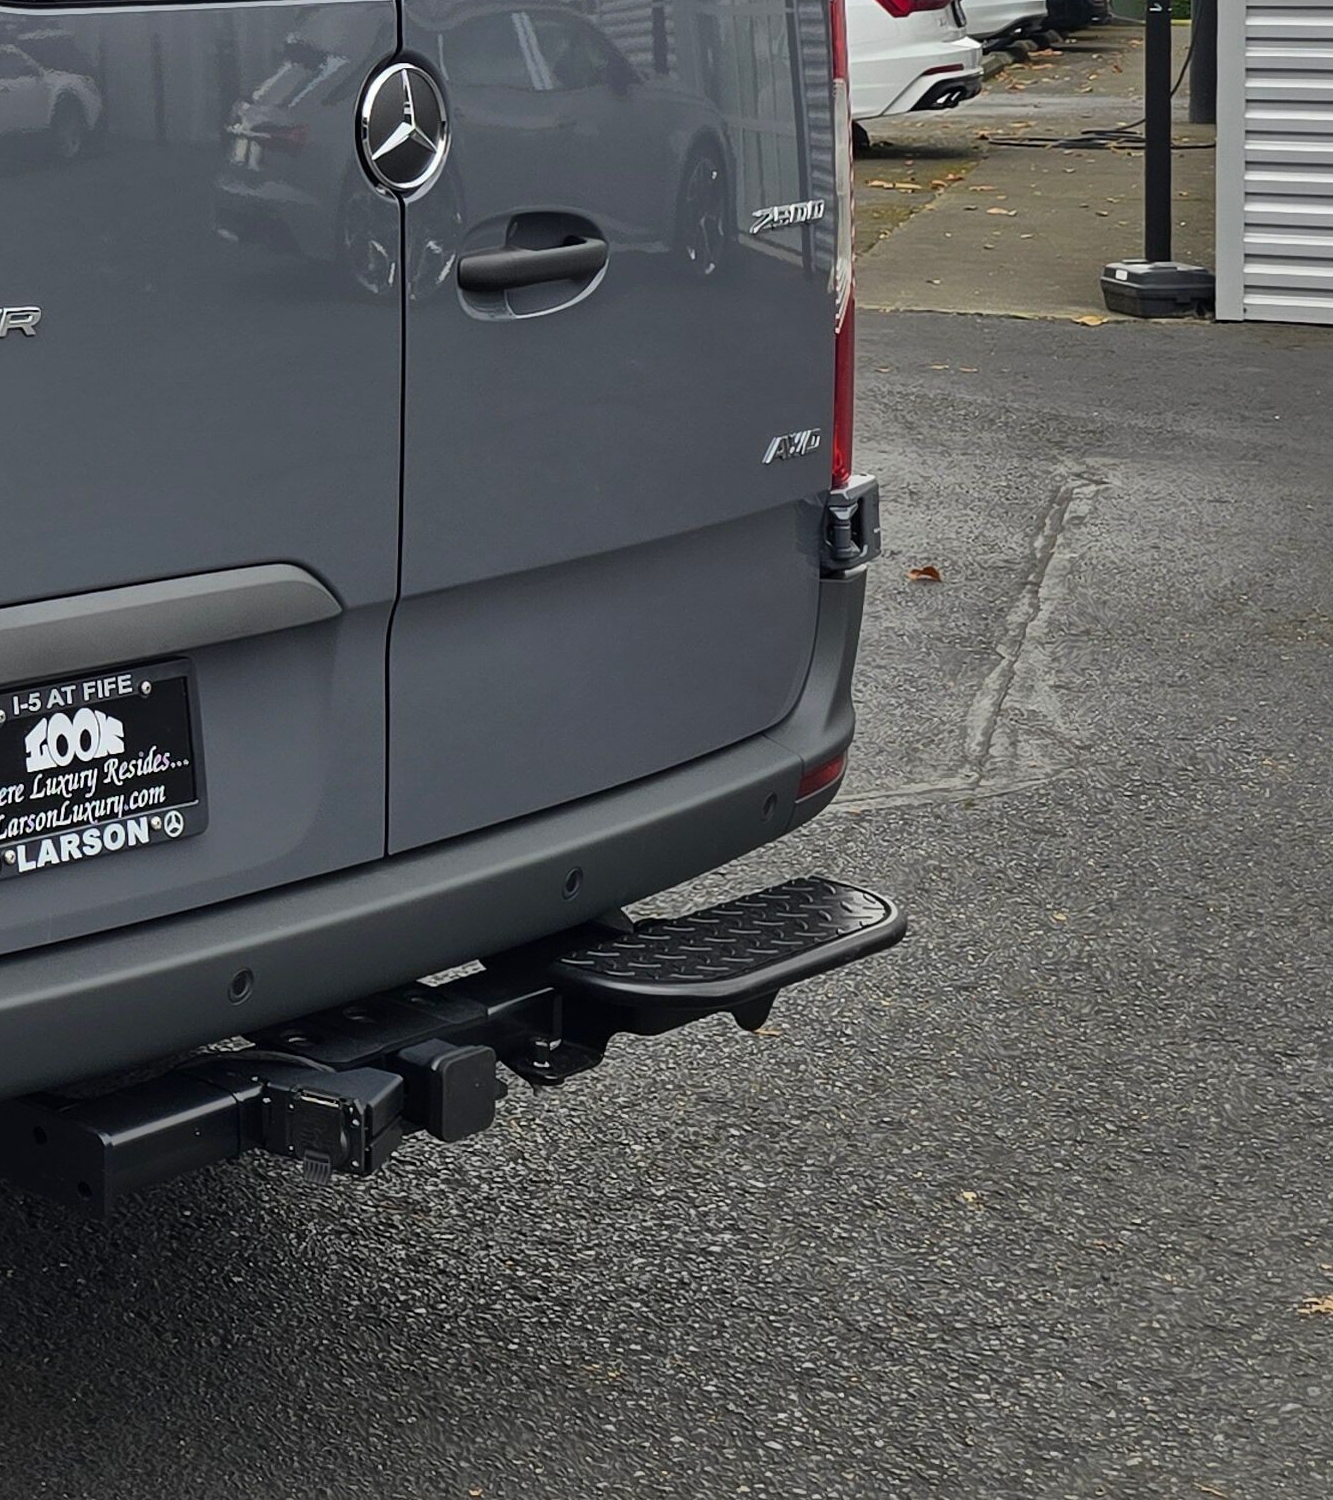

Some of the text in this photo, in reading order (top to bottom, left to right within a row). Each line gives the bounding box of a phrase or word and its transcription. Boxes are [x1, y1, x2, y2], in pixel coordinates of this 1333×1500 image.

[12, 674, 133, 716] I-5 AT FIFE
[25, 708, 125, 772] LOOK
[30, 769, 97, 799] Luxury
[104, 746, 189, 784] Resides...
[17, 817, 150, 872] LARSON
